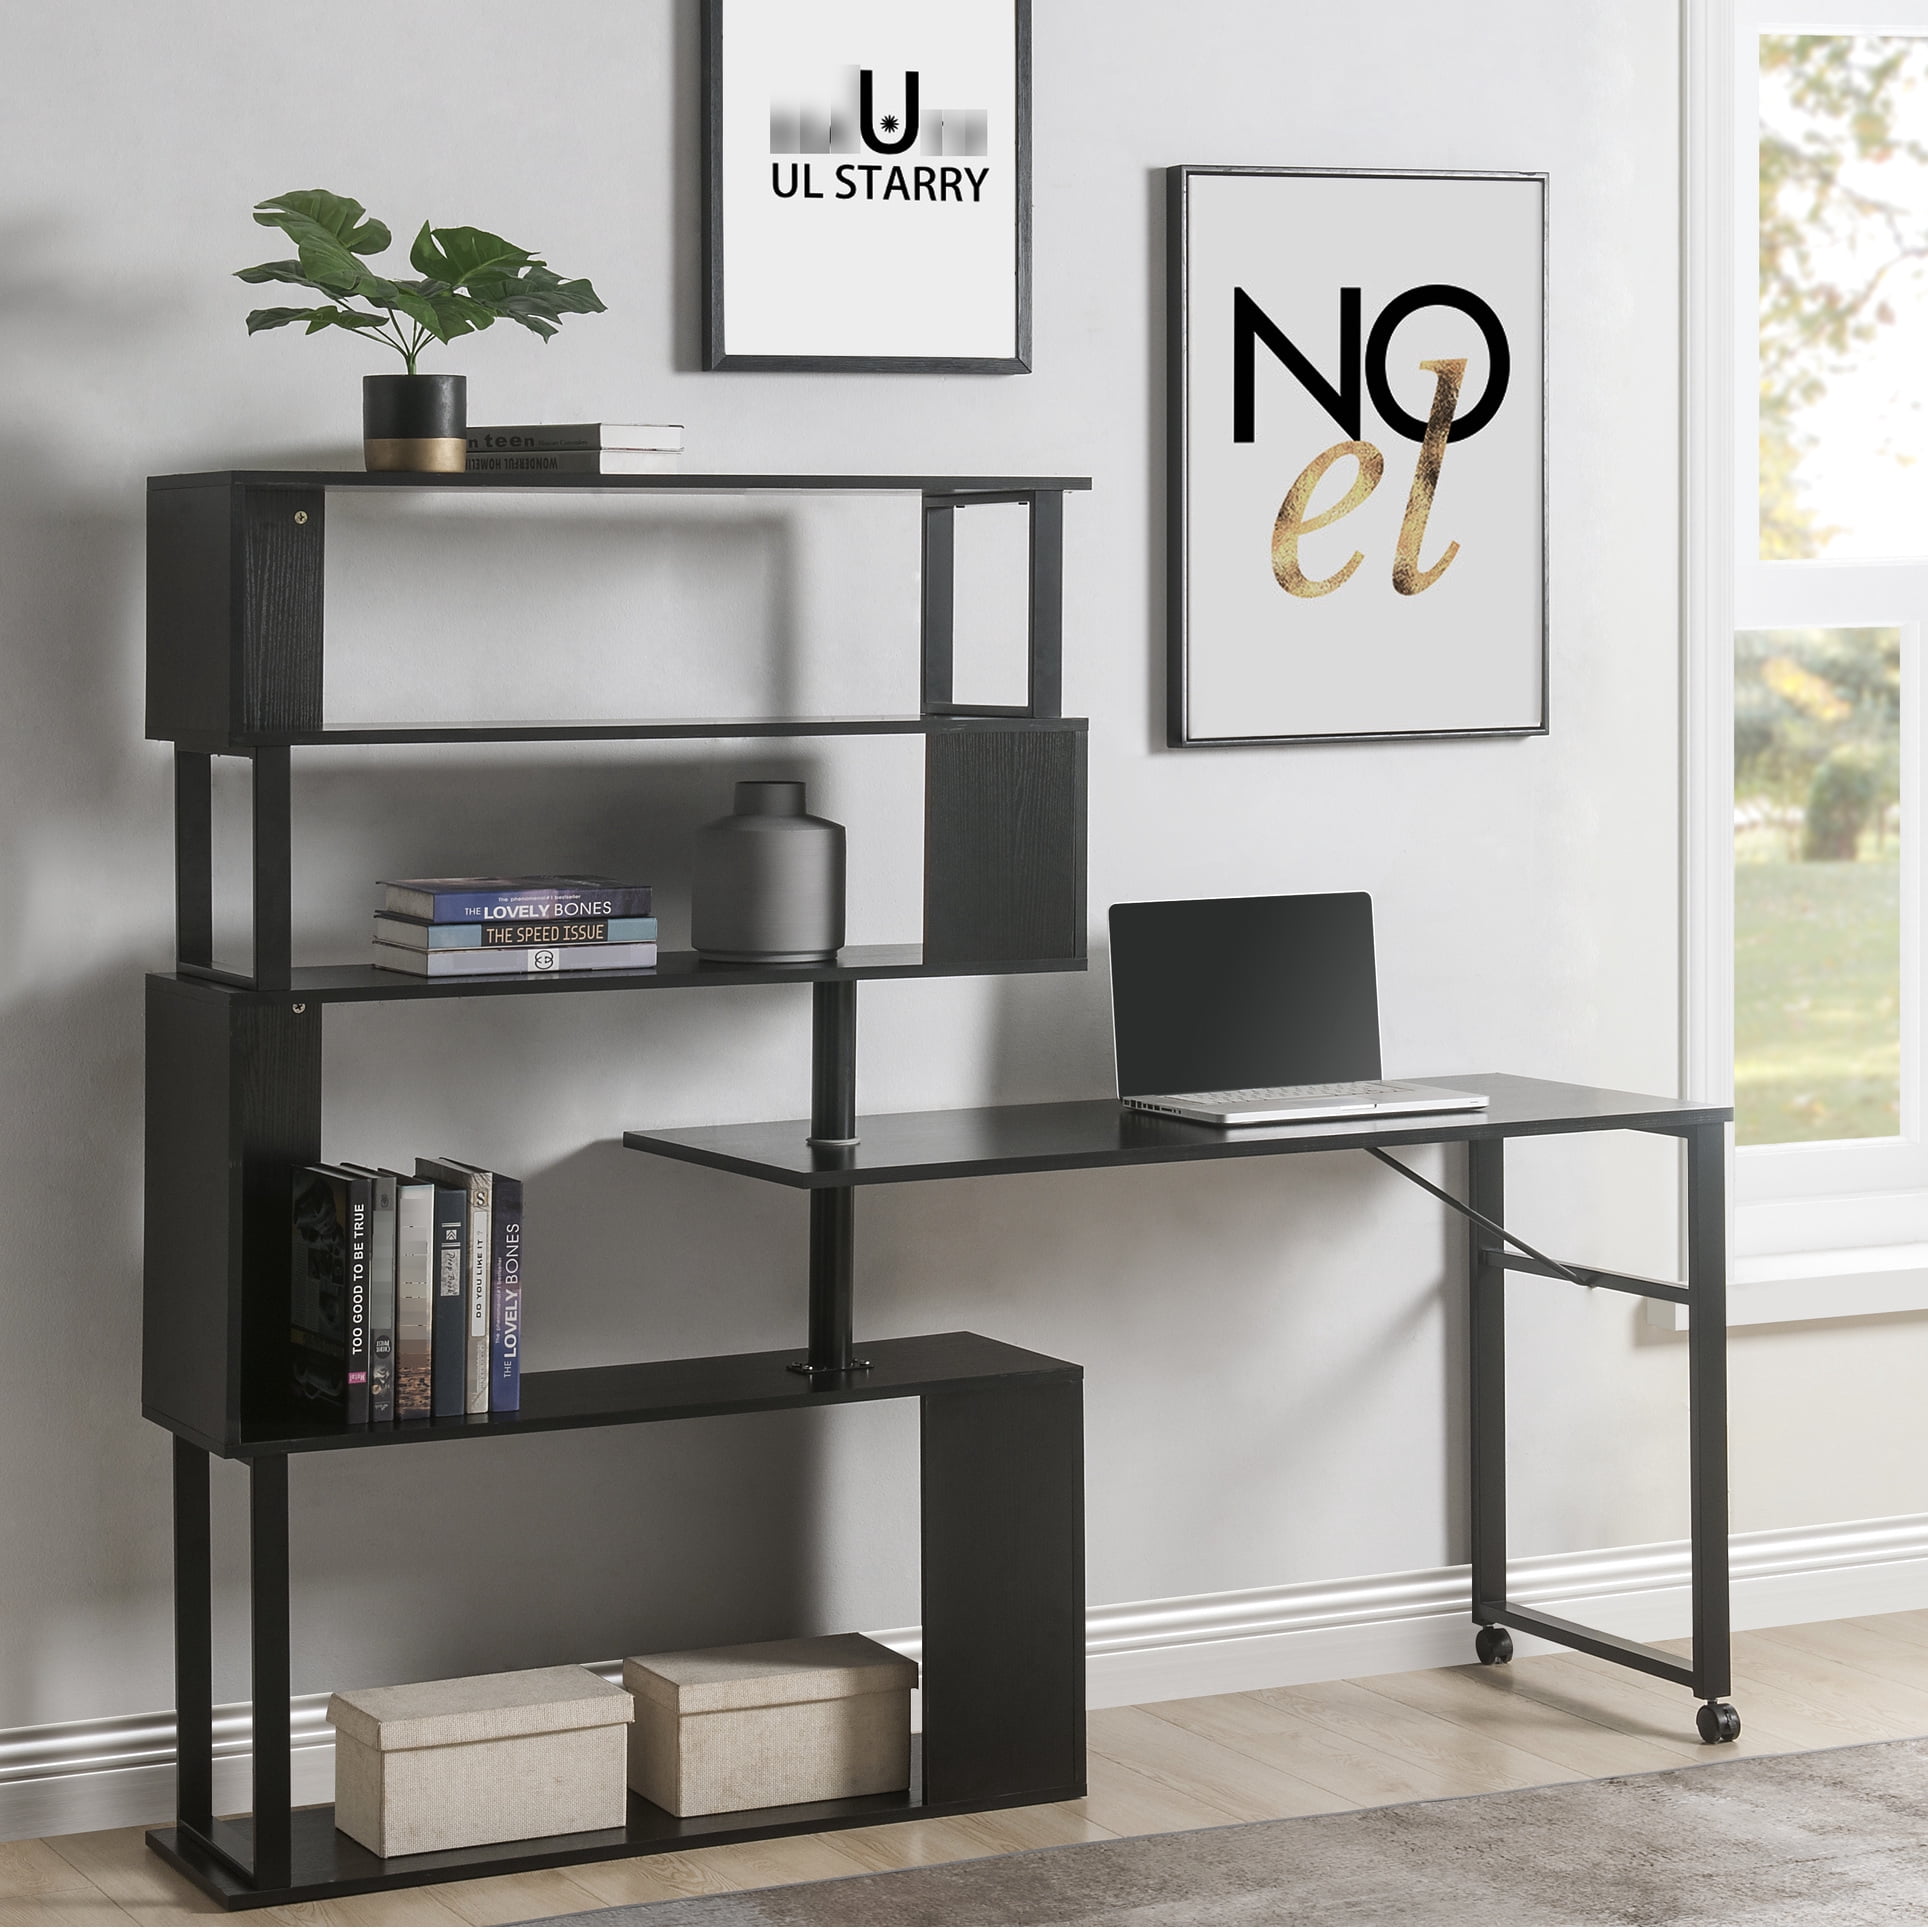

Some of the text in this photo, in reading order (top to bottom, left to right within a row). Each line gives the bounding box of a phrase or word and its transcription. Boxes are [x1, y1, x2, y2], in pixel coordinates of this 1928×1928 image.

[860, 69, 919, 155] U
[772, 162, 990, 202] UL STARRY
[484, 434, 535, 448] teen
[505, 457, 558, 471] WONDERFUL
[465, 901, 612, 920] THE LOVELY BONES
[486, 924, 604, 943] THE SPEED ISSUE
[476, 1239, 483, 1249] IT
[352, 1203, 365, 1355] TOO GOOD TO BE TRUE
[503, 1223, 520, 1378] THE LOVELY BONES
[475, 1303, 482, 1319] DO
